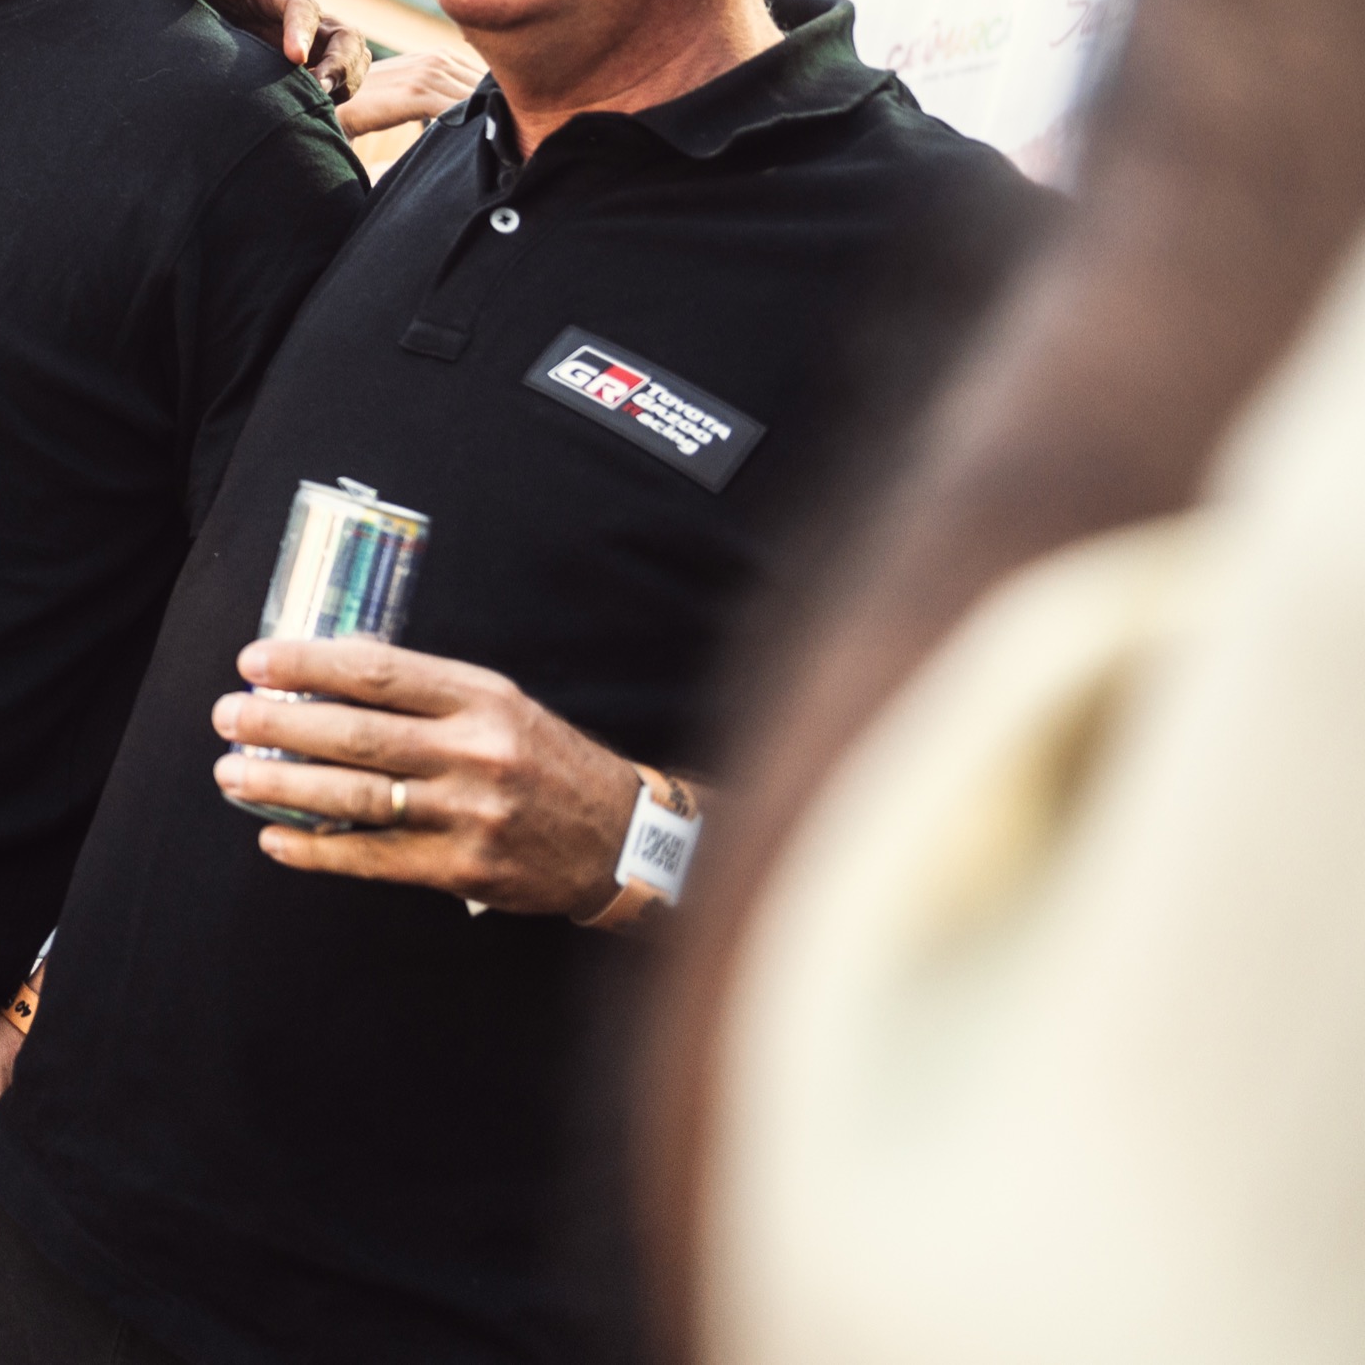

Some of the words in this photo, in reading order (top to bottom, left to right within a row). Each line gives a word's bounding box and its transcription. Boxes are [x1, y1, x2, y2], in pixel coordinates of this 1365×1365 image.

[555, 360, 629, 404] GR
[621, 401, 700, 456] Racing
[631, 392, 714, 445] GAZOO
[647, 381, 733, 441] TOYOTA
